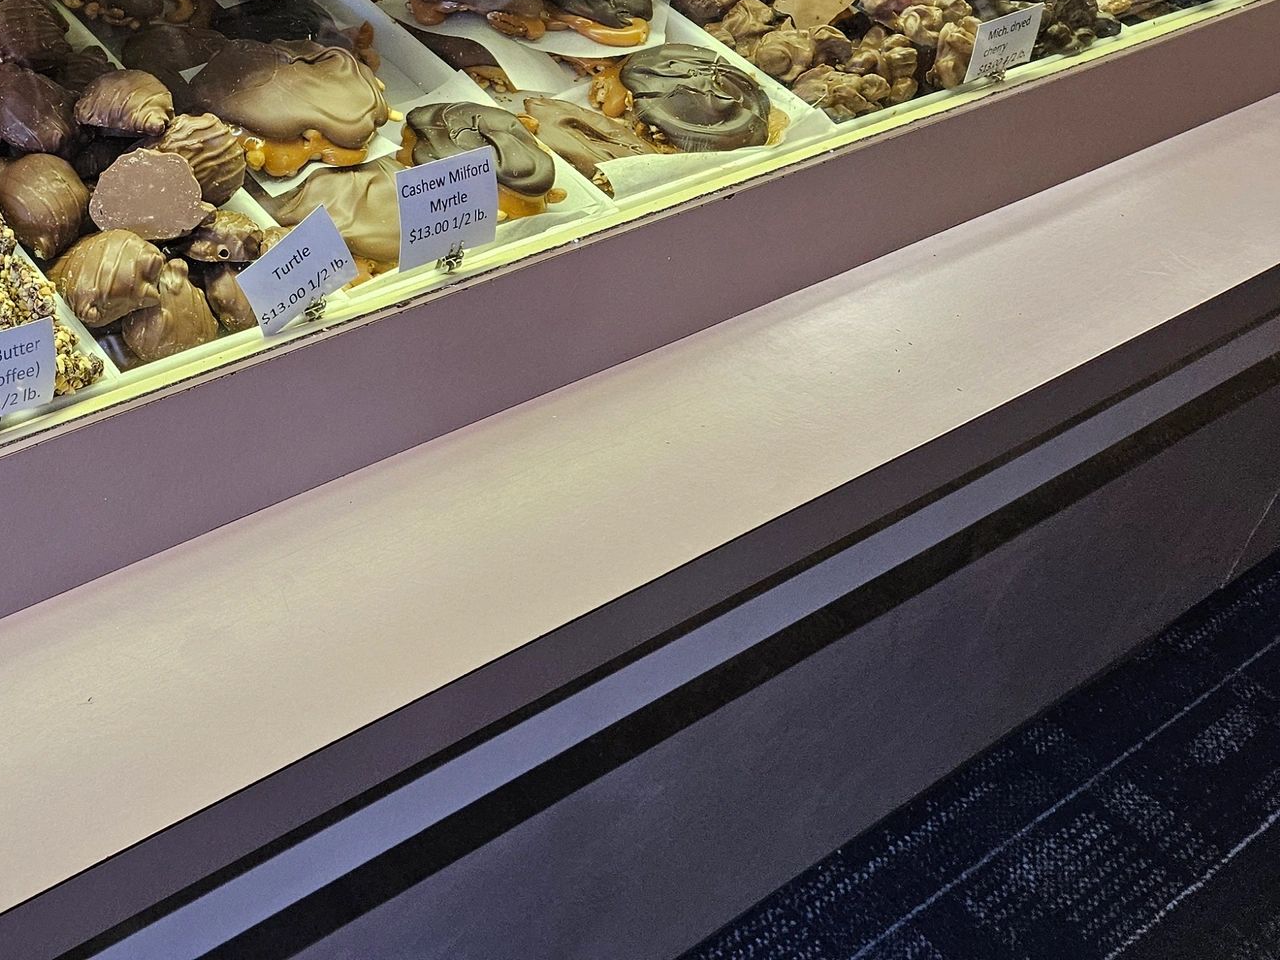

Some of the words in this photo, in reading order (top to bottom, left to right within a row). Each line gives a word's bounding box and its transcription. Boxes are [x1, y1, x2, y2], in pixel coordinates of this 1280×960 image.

[988, 26, 1009, 40] Mich.
[401, 176, 446, 199] Cashew
[448, 160, 490, 185] Milford
[430, 192, 468, 215] Myrtle
[409, 220, 449, 244] $13.00
[452, 212, 472, 231] 1/2
[474, 209, 487, 222] lb.
[272, 244, 311, 281] Turtle
[261, 287, 306, 325] $13.00
[307, 266, 331, 292] 1/2
[330, 256, 349, 276] lb.
[23, 387, 41, 402] lb.
